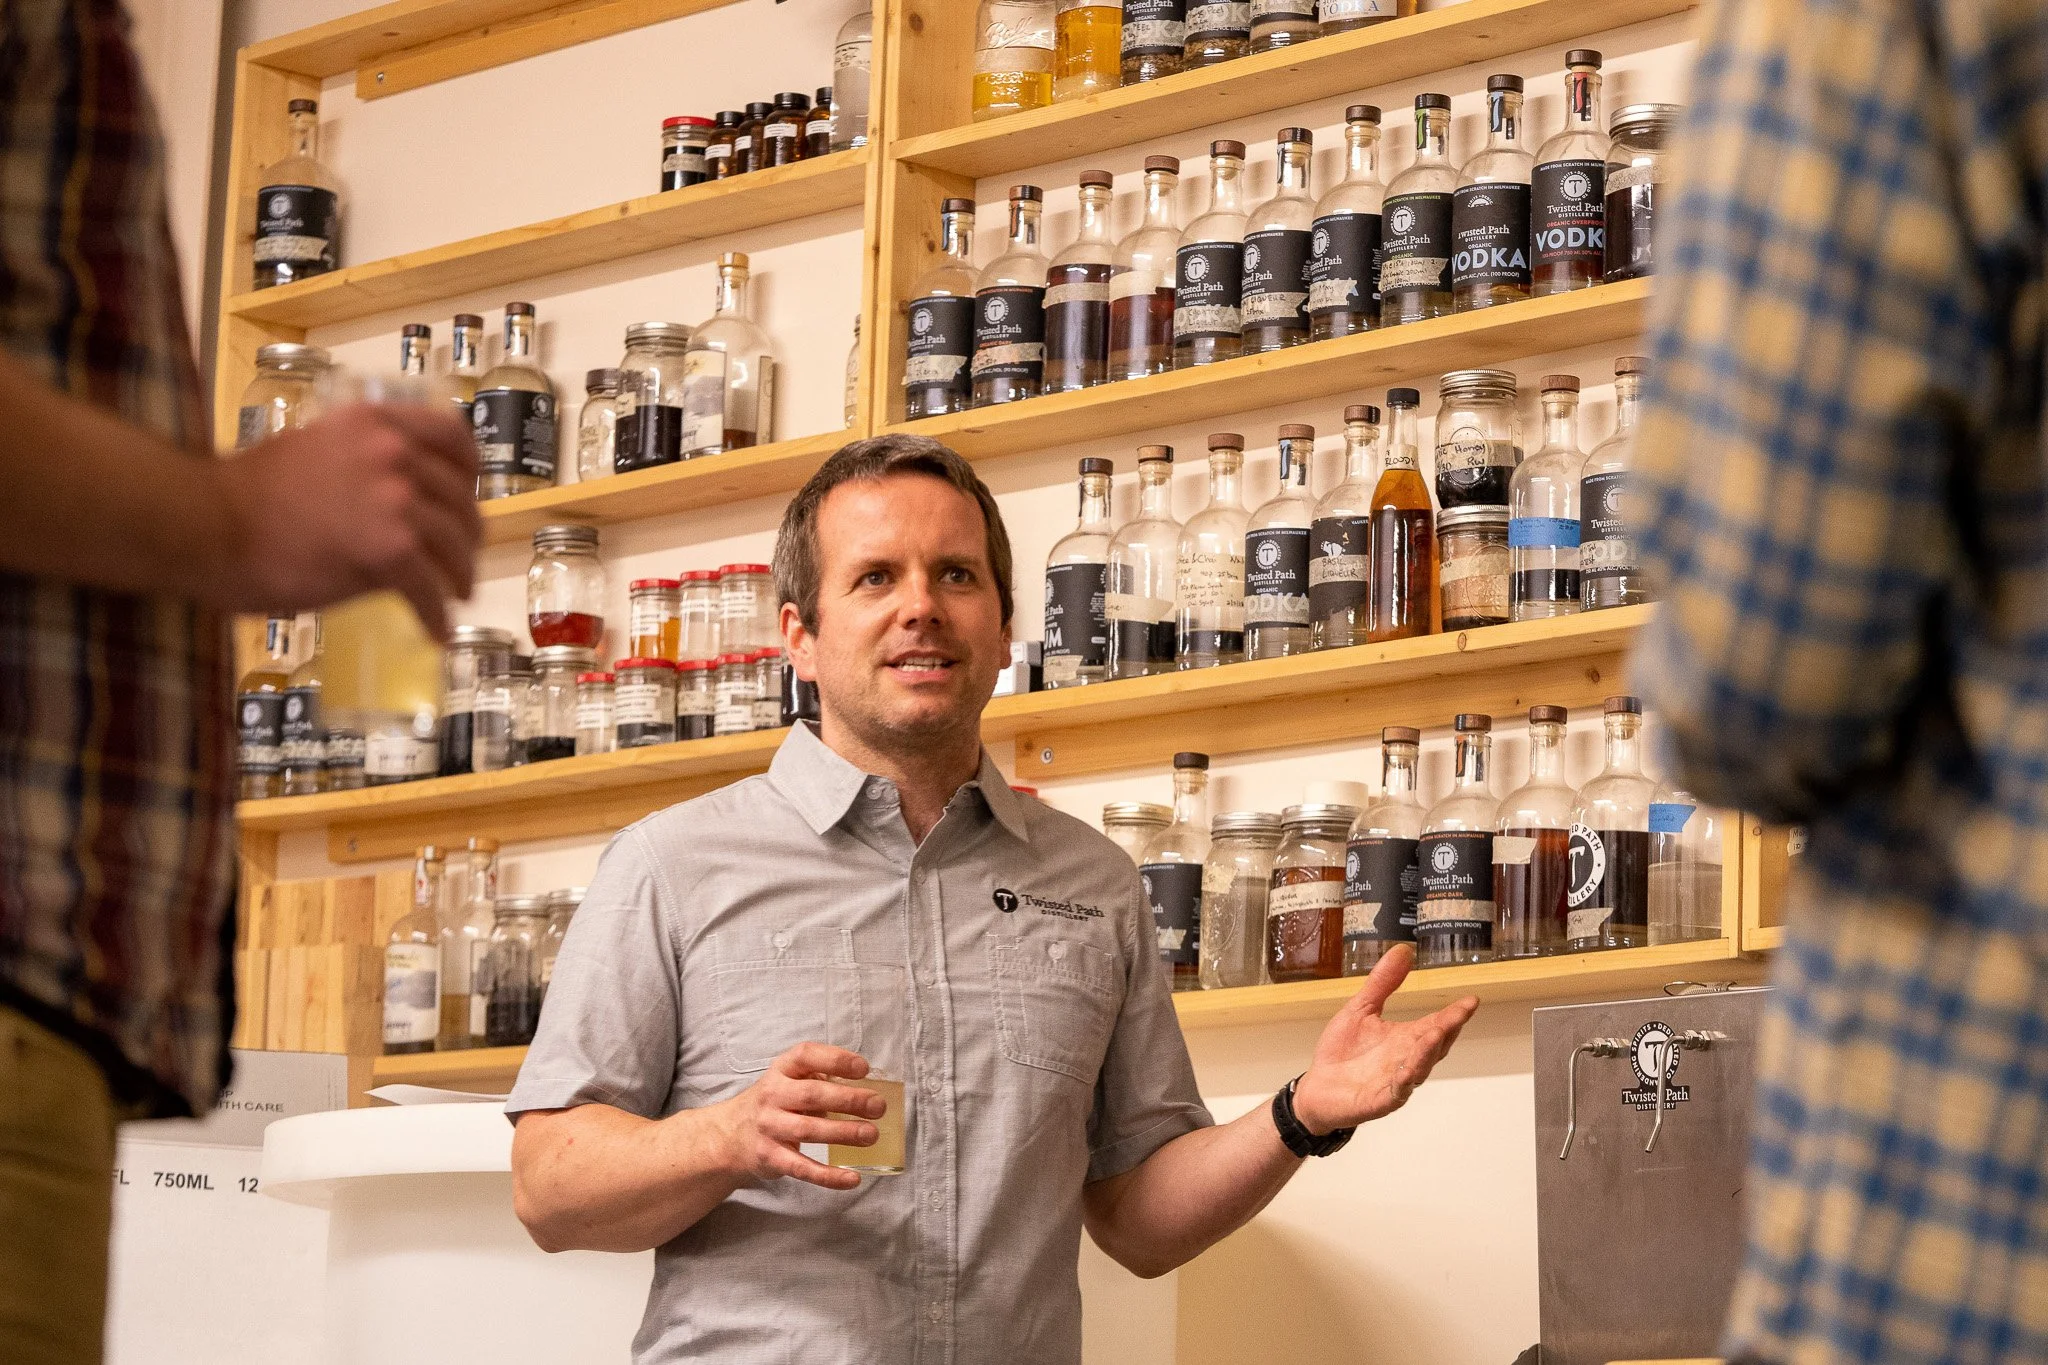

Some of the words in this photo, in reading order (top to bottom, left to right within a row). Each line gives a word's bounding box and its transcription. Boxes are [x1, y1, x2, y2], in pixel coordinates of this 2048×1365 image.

[1547, 202, 1582, 214] Twisted
[1458, 226, 1486, 240] Twisted
[1488, 224, 1510, 234] Path
[1383, 236, 1408, 251] Twisted
[1410, 234, 1431, 244] Path
[1536, 227, 1604, 252] VODK
[1389, 244, 1418, 253] DISTILLERY
[1325, 255, 1342, 265] Path
[1452, 248, 1526, 275] VODKA
[1255, 270, 1272, 280] Path
[1312, 266, 1330, 275] ISTILLERY
[1177, 283, 1201, 296] Twisted
[1203, 282, 1224, 291] Path
[1002, 324, 1022, 333] Path
[927, 334, 946, 344] Path
[1248, 570, 1272, 582] Twisted
[1275, 569, 1296, 579] Path
[1246, 592, 1309, 614] ODKA
[1044, 627, 1062, 650] UM
[1582, 827, 1602, 851] PATH
[1355, 880, 1371, 891] Path
[1422, 875, 1449, 887] Twisted
[1452, 874, 1473, 884] Path
[1022, 894, 1073, 912] Twisted
[1075, 904, 1104, 917] Path
[1041, 910, 1088, 921] DISTILLERY
[1632, 1024, 1651, 1051] SPIRITS
[1658, 1023, 1678, 1066] DEDIATED
[1632, 1056, 1658, 1086] ANDERING
[1666, 1070, 1675, 1079] TO
[1623, 1088, 1657, 1103] Twiste
[1666, 1087, 1688, 1100] Path
[245, 1103, 284, 1113] CARE
[153, 1172, 214, 1190] 750ML
[238, 1177, 258, 1194] 12
